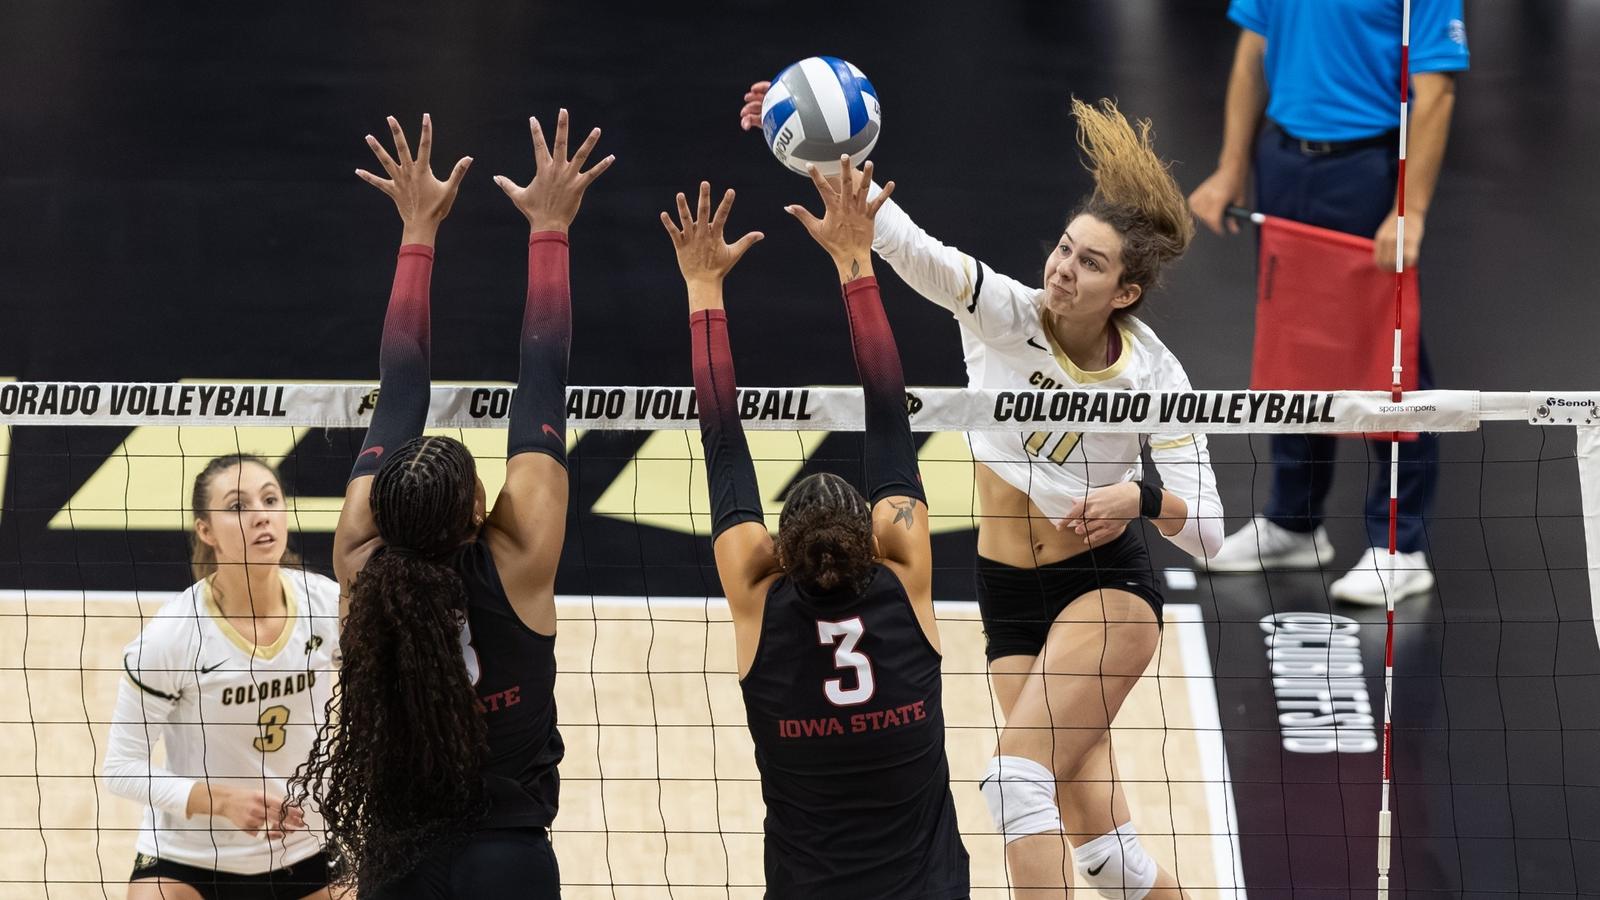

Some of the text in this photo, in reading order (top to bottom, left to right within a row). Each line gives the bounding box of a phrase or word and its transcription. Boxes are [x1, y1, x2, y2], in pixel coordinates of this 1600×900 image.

[110, 385, 287, 417] VOLLEYBALL
[469, 388, 811, 420] COADO VOLLBALL
[993, 391, 1335, 424] COLORADO VOLLEYBALL
[1557, 397, 1596, 408] Senoh
[816, 615, 877, 708] 3
[222, 670, 317, 706] COLORADO
[252, 704, 291, 753] 3
[778, 700, 927, 738] IOWA STATE
